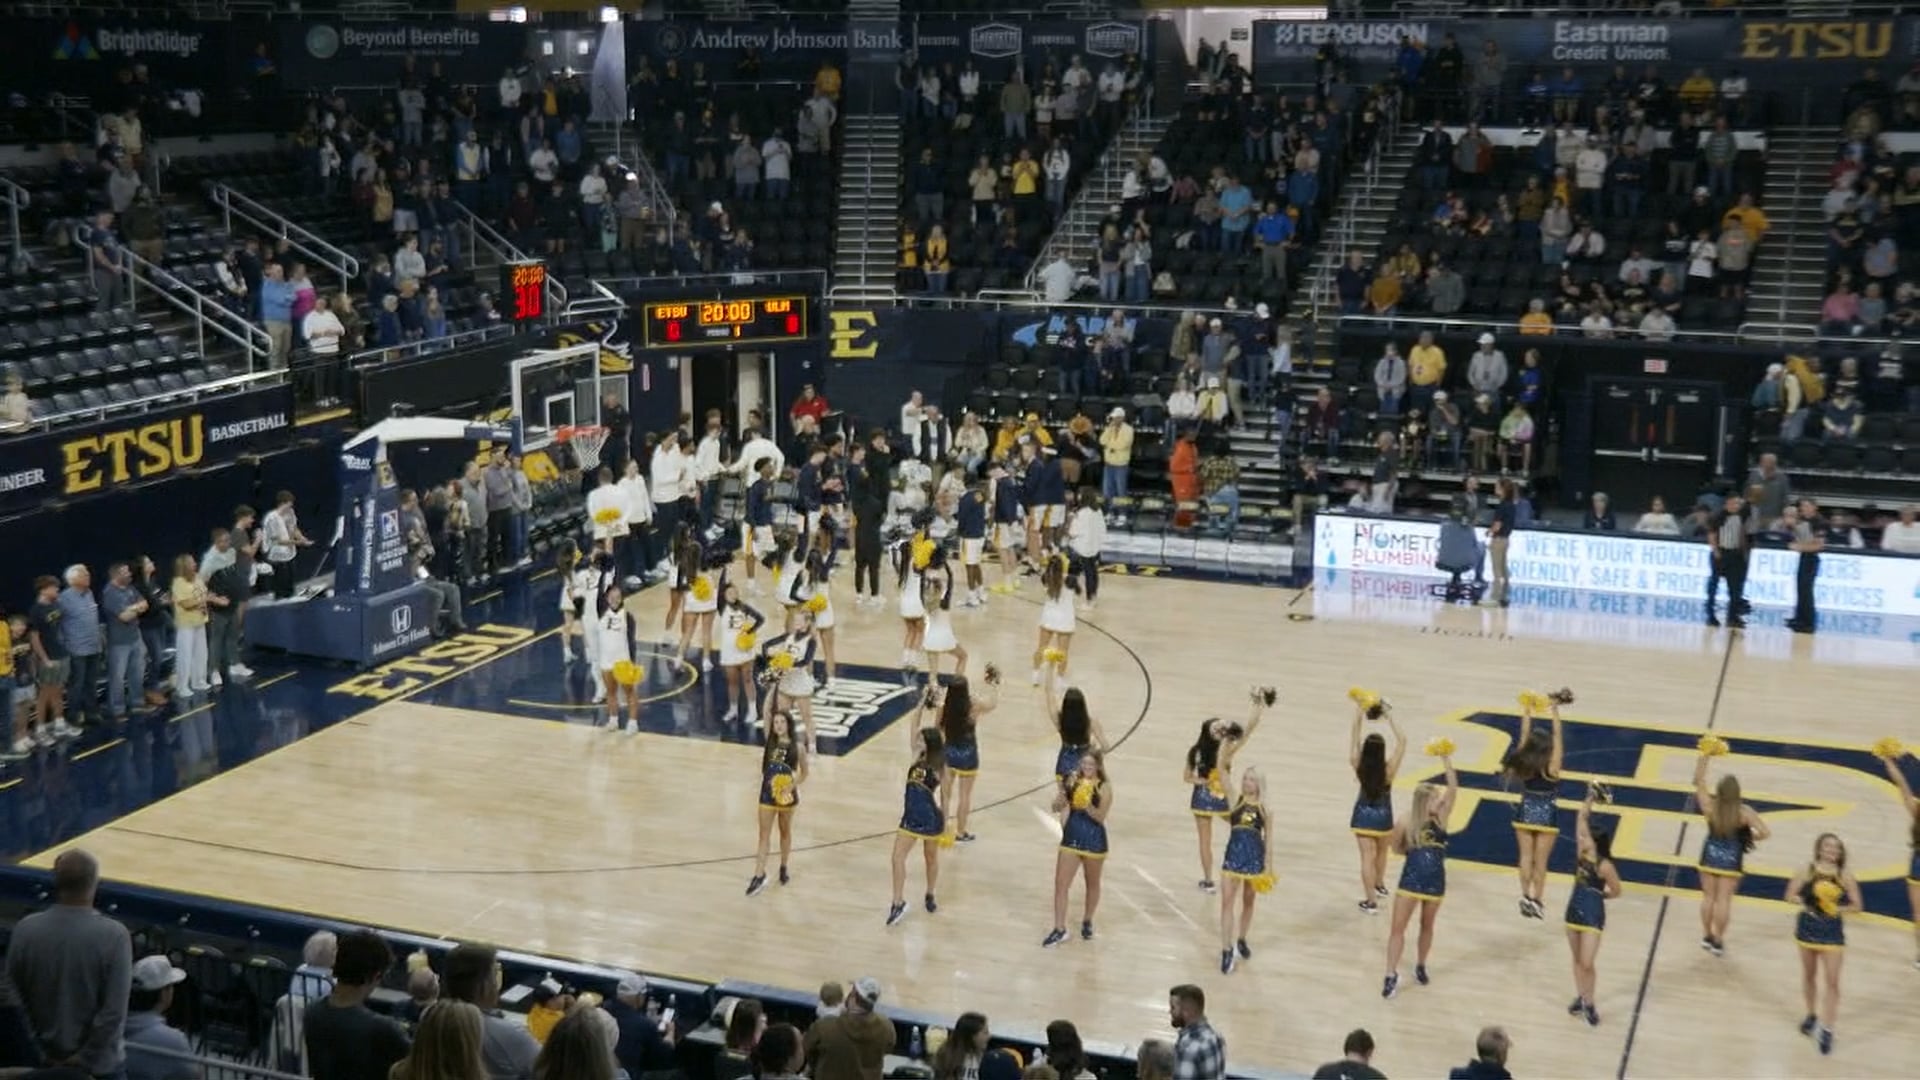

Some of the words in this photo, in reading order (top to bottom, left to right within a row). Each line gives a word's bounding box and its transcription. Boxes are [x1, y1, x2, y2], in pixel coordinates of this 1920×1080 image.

[98, 28, 199, 57] BrightRidge
[343, 27, 405, 48] Beyond
[411, 27, 480, 45] Benefits
[691, 26, 768, 48] Andrew
[773, 26, 848, 51] Johnson
[853, 27, 902, 48] Bank
[1297, 23, 1428, 44] FERGUSON
[1555, 21, 1668, 42] Eastman
[1742, 22, 1893, 59] ETSU
[1552, 45, 1607, 60] Credit
[1614, 45, 1668, 60] Union
[514, 285, 541, 319] 30
[702, 302, 750, 323] 20:00
[829, 311, 878, 358] E
[62, 414, 204, 494] ETSU
[211, 412, 289, 443] BASKETBALL
[1354, 523, 1440, 551] HOMET
[1352, 549, 1438, 567] PLUMBIN
[1526, 535, 1579, 559] WE'RE
[1587, 540, 1634, 564] YOUR
[1642, 547, 1710, 569] HOMET
[1757, 553, 1862, 580] PLUERS
[1508, 560, 1582, 586] RIENDLY,
[1591, 566, 1631, 588] SAFE
[1637, 572, 1648, 588] &
[326, 623, 535, 699] ETSU
